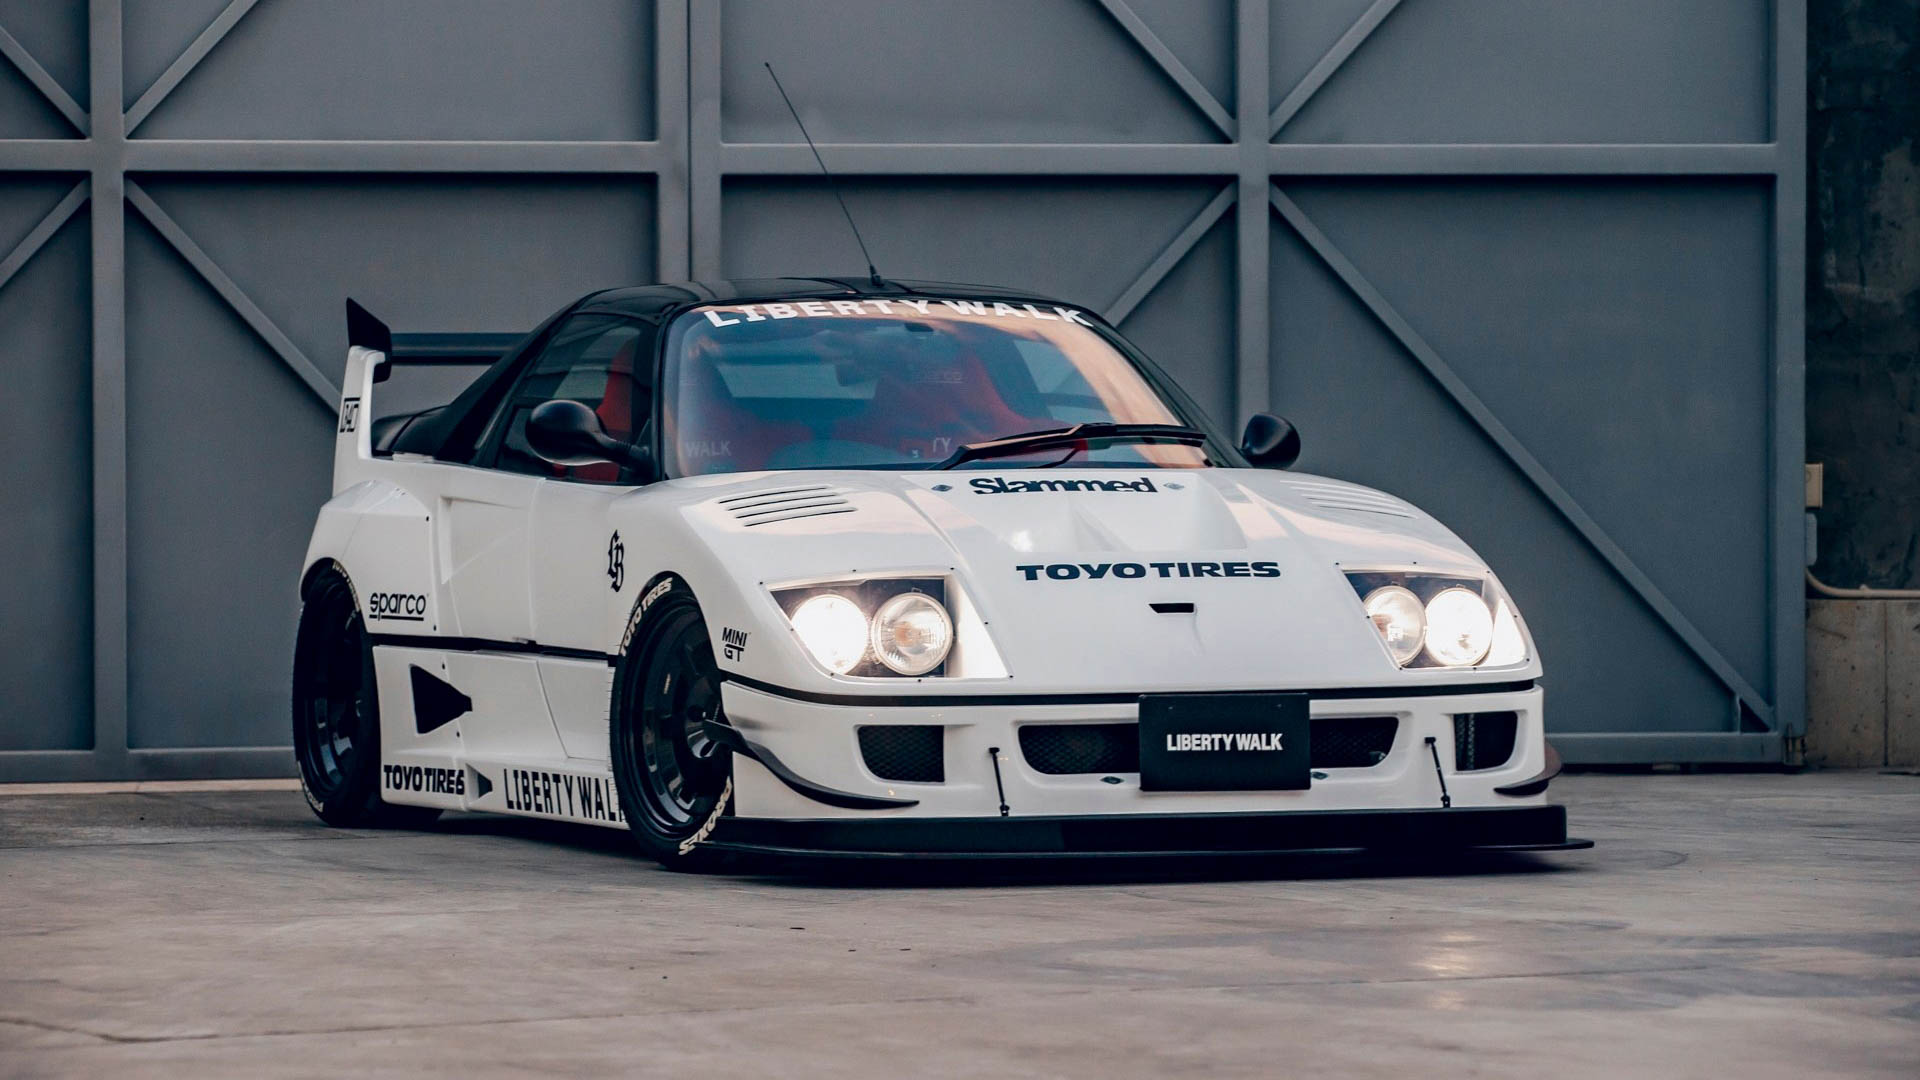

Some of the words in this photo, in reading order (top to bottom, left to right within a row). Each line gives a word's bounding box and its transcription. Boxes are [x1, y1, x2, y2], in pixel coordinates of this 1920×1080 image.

[704, 299, 931, 328] LIBERTY
[941, 299, 1094, 328] WALK
[968, 477, 1159, 495] Slammed
[1016, 562, 1147, 581] TOYO
[1148, 561, 1281, 578] TIRES
[369, 592, 427, 621] sparco
[619, 606, 643, 657] TOYO
[721, 626, 748, 648] MINI
[723, 643, 745, 662] GT
[1166, 733, 1235, 751] LIBERTY
[1235, 732, 1284, 751] WALK
[383, 764, 423, 793] TOYO
[503, 768, 574, 817] LIBERTY
